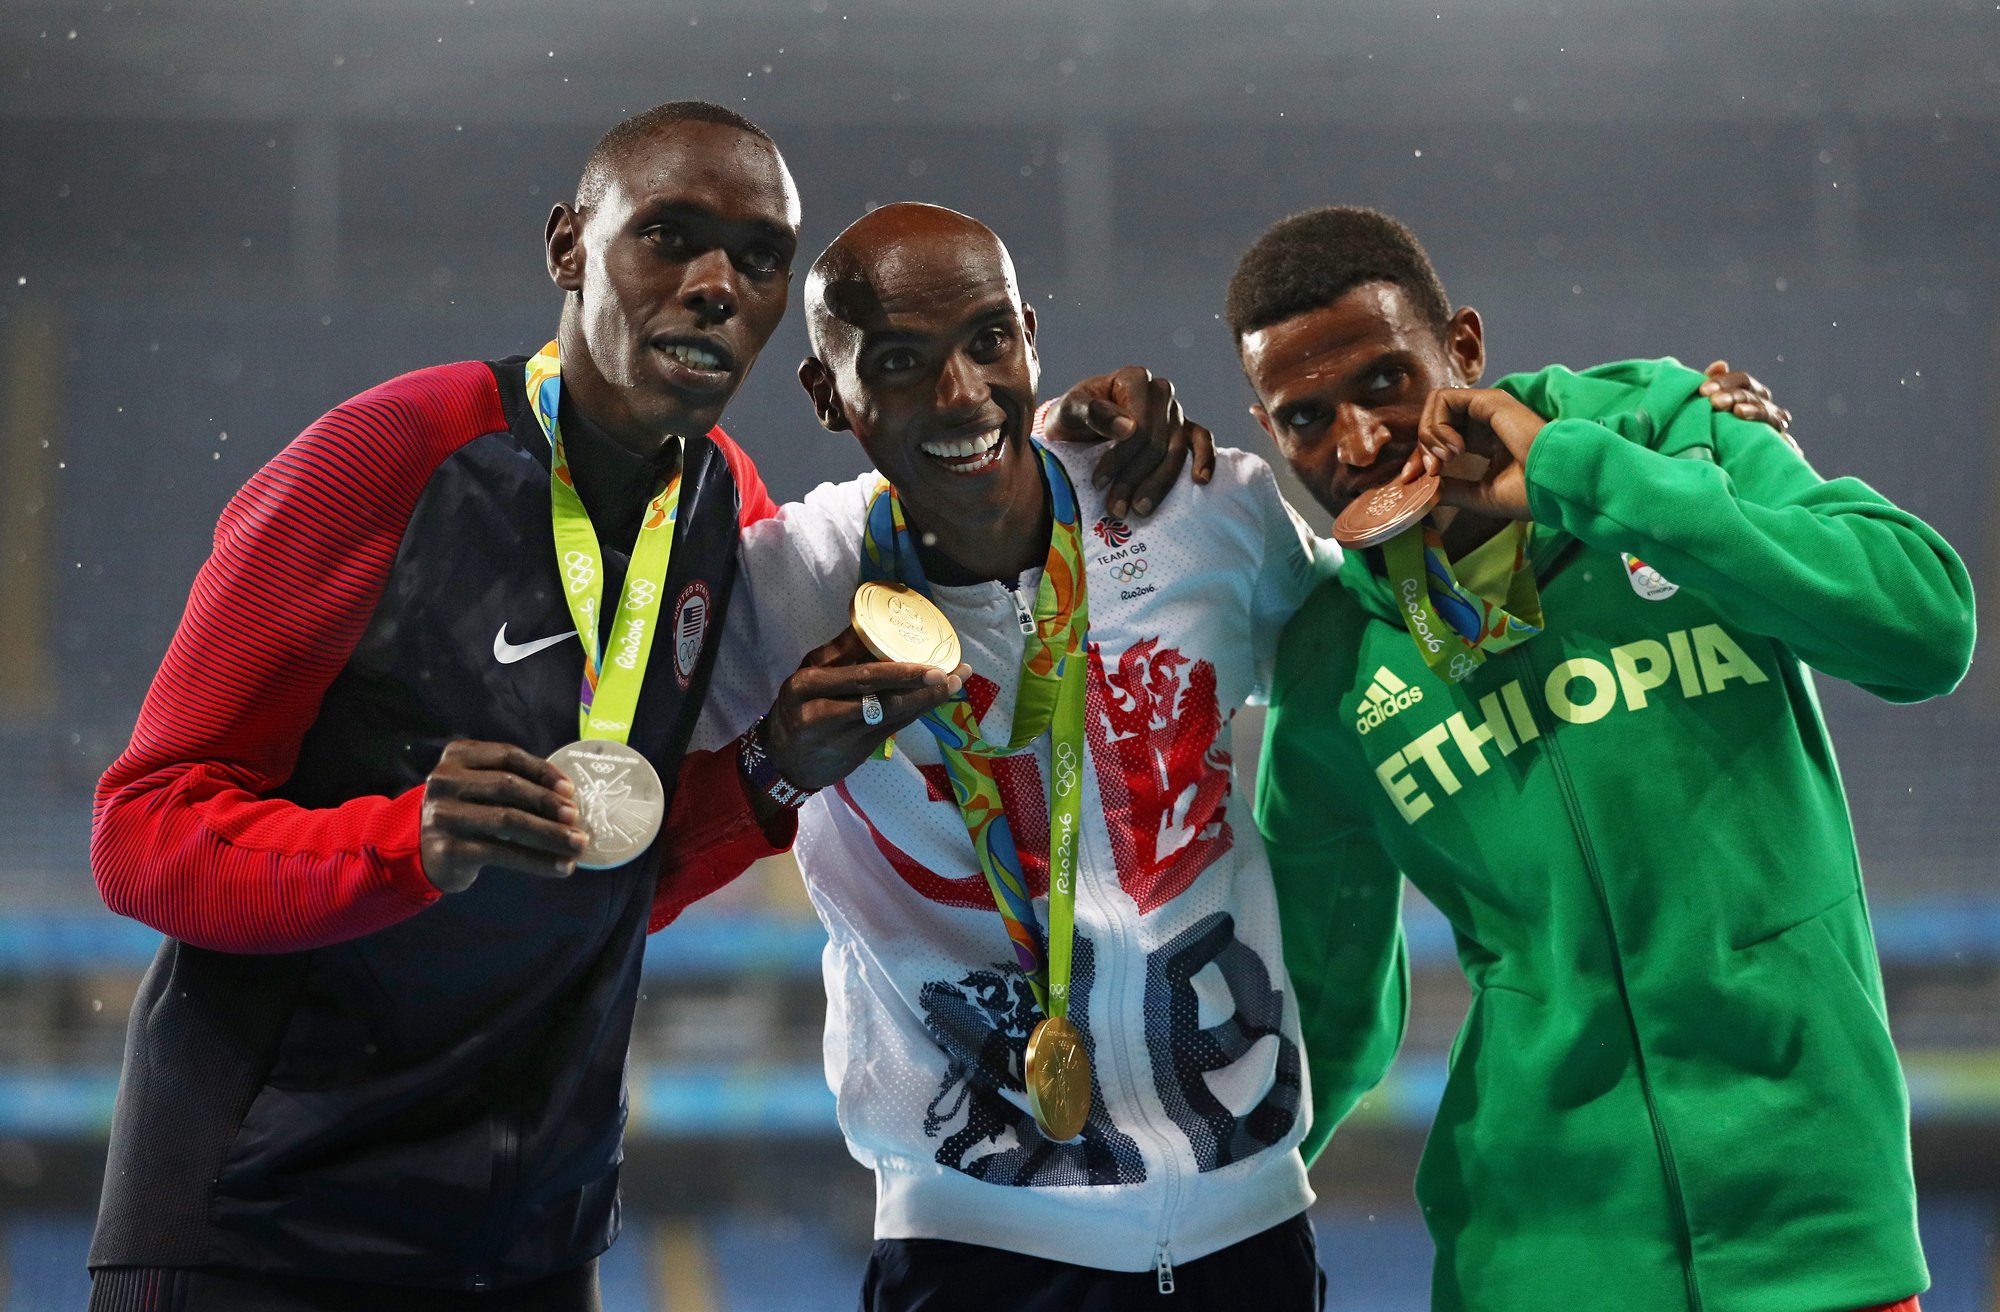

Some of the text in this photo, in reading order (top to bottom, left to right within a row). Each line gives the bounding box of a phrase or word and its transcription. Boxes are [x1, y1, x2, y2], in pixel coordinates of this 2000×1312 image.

[1097, 543, 1147, 565] TEAM GB
[674, 585, 694, 620] UNITED
[1356, 685, 1424, 735] adidas
